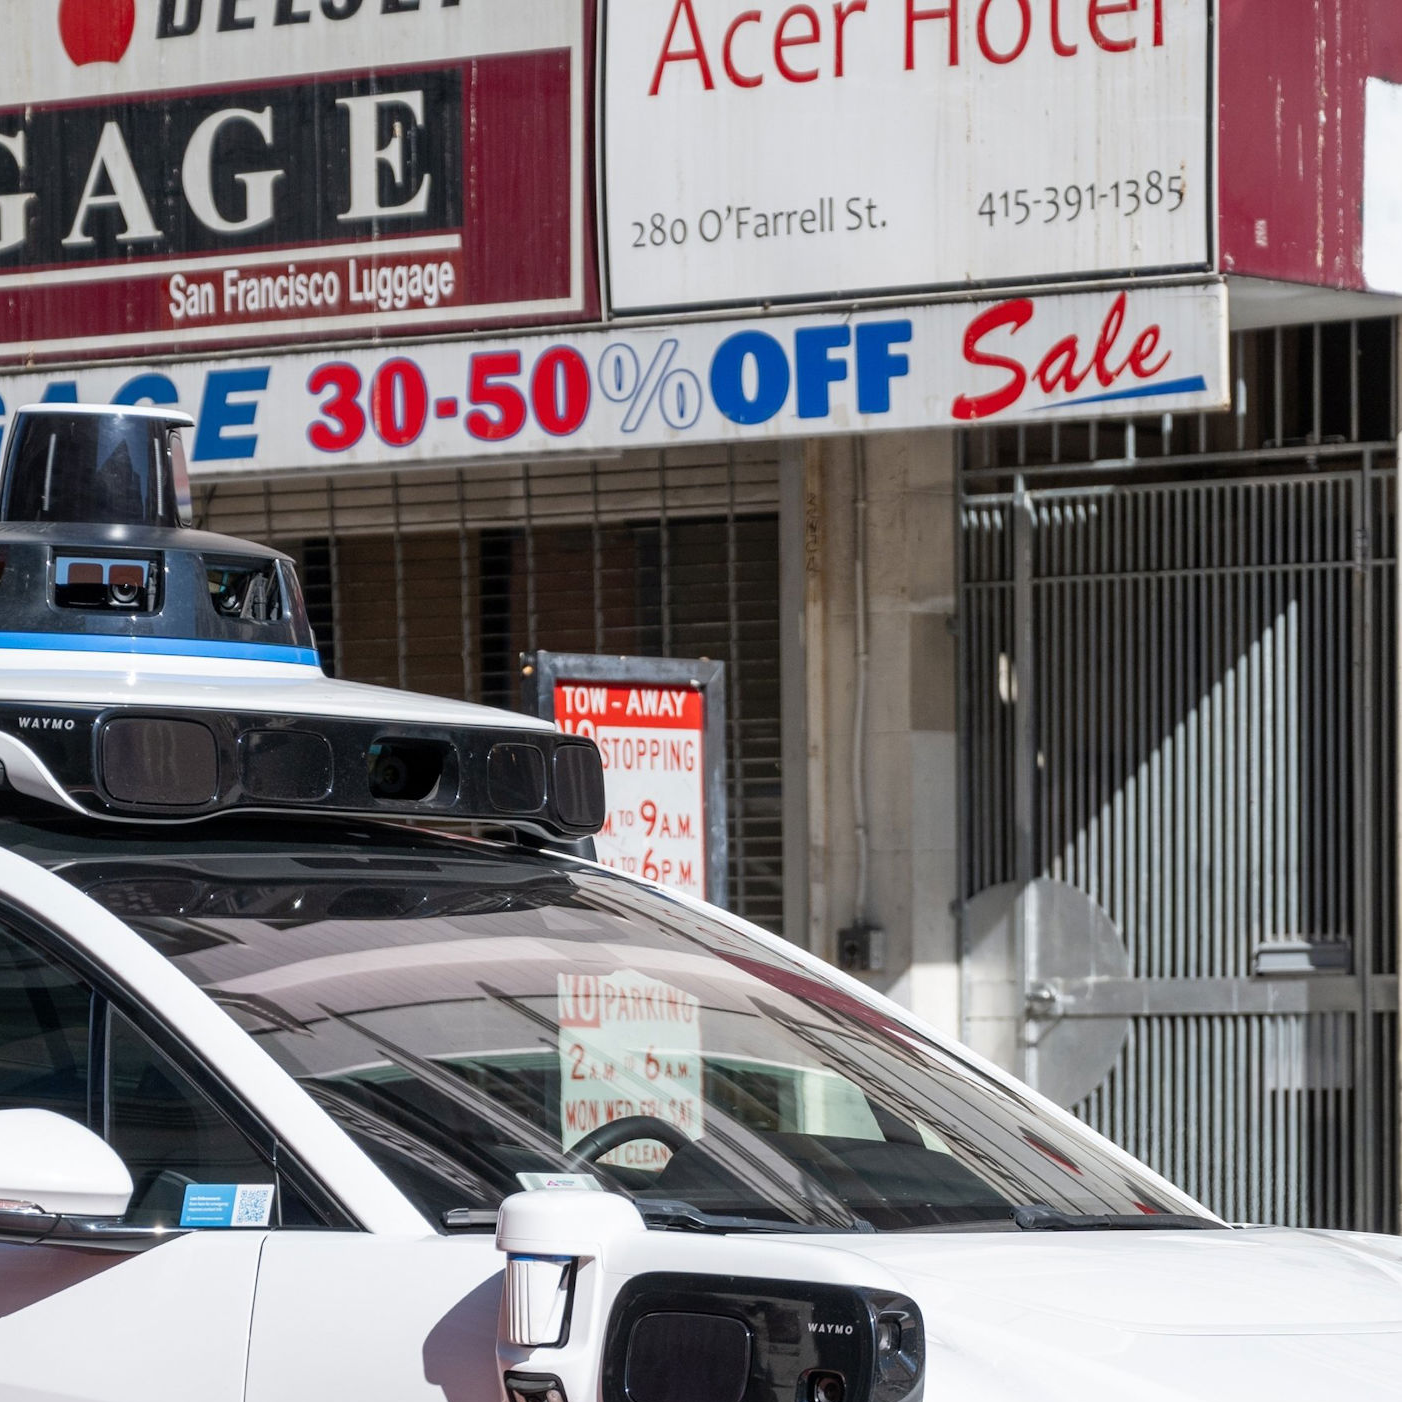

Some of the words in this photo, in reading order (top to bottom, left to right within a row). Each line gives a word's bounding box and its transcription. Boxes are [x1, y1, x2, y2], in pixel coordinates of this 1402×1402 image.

[649, 0, 866, 96] Acer
[631, 212, 688, 249] 280
[697, 198, 835, 243] O'Farrell
[845, 197, 888, 231] St.
[977, 169, 1186, 227] 415-391-1385
[168, 273, 216, 320] San
[223, 264, 340, 316] Francisco
[348, 258, 456, 311] Luggage
[709, 320, 913, 426] OFF
[951, 290, 1172, 421] Sale
[18, 716, 75, 731] WAYMO
[602, 737, 694, 772] STOPPING
[619, 809, 634, 828] TO
[639, 799, 658, 837] 9
[659, 813, 696, 840] A.M.
[642, 848, 660, 884] 6
[569, 1043, 585, 1080] 2
[665, 1062, 692, 1079] A.M.
[566, 1099, 599, 1132] MON
[807, 1321, 853, 1336] WAYMO
